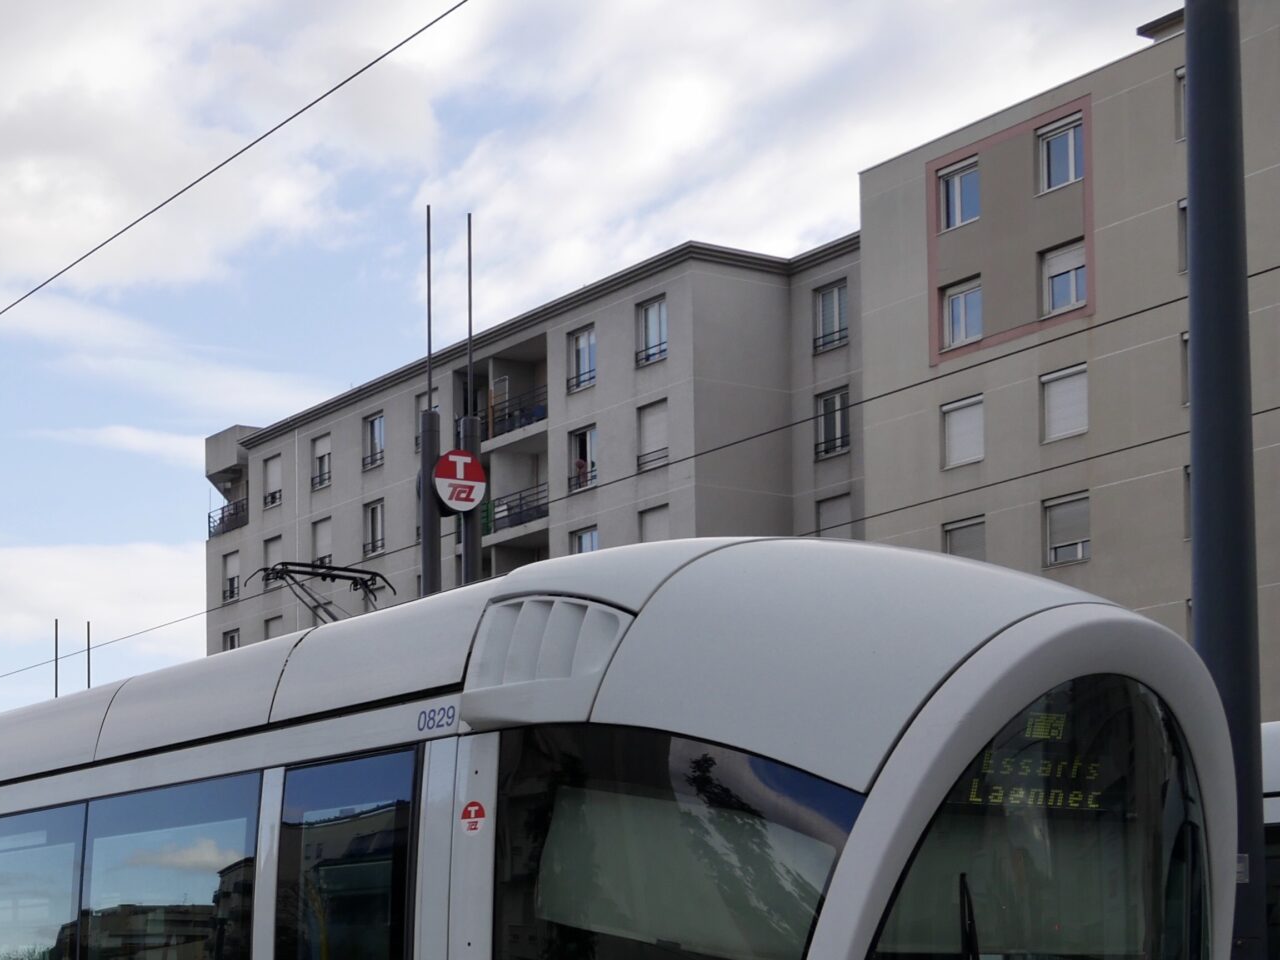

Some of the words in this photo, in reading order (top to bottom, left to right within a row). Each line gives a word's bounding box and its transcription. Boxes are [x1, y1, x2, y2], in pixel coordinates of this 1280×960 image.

[448, 455, 472, 479] T
[417, 705, 456, 731] 0829
[981, 751, 1100, 780] Essarts
[969, 778, 1101, 808] Laennec
[467, 806, 479, 818] T
